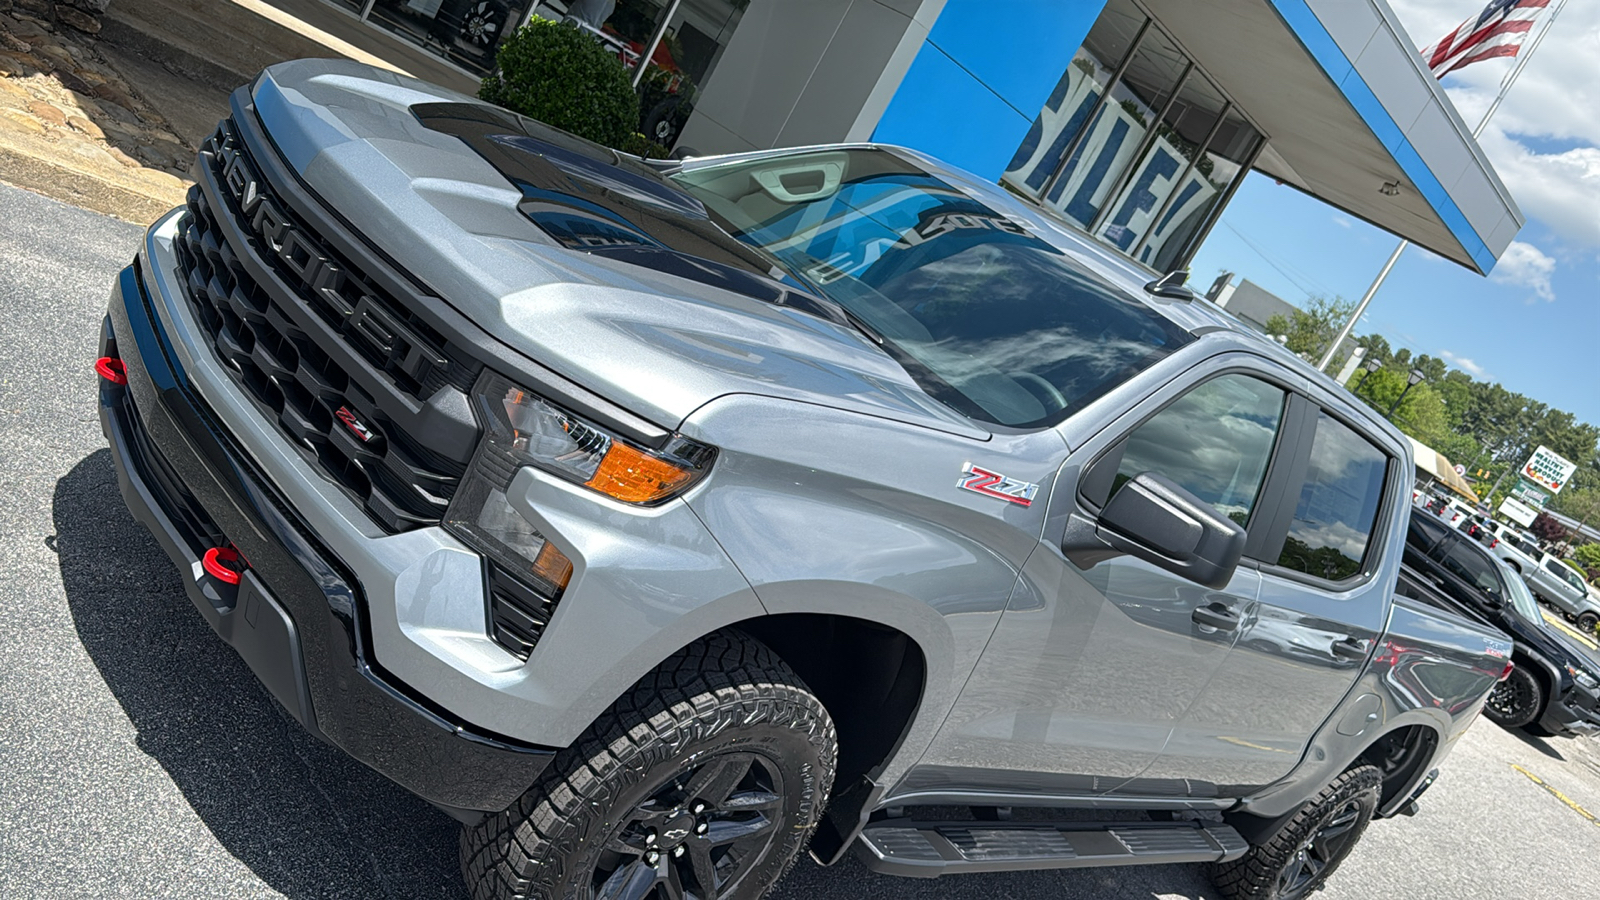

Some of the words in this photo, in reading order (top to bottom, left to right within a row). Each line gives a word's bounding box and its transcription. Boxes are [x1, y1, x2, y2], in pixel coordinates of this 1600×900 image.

[209, 118, 449, 381] CHEVROLET
[335, 405, 374, 442] Z71
[1533, 465, 1564, 486] PRODUCE
[1534, 459, 1565, 479] HARVEST
[1535, 452, 1564, 471] HEALTHY
[956, 461, 1040, 507] Z71
